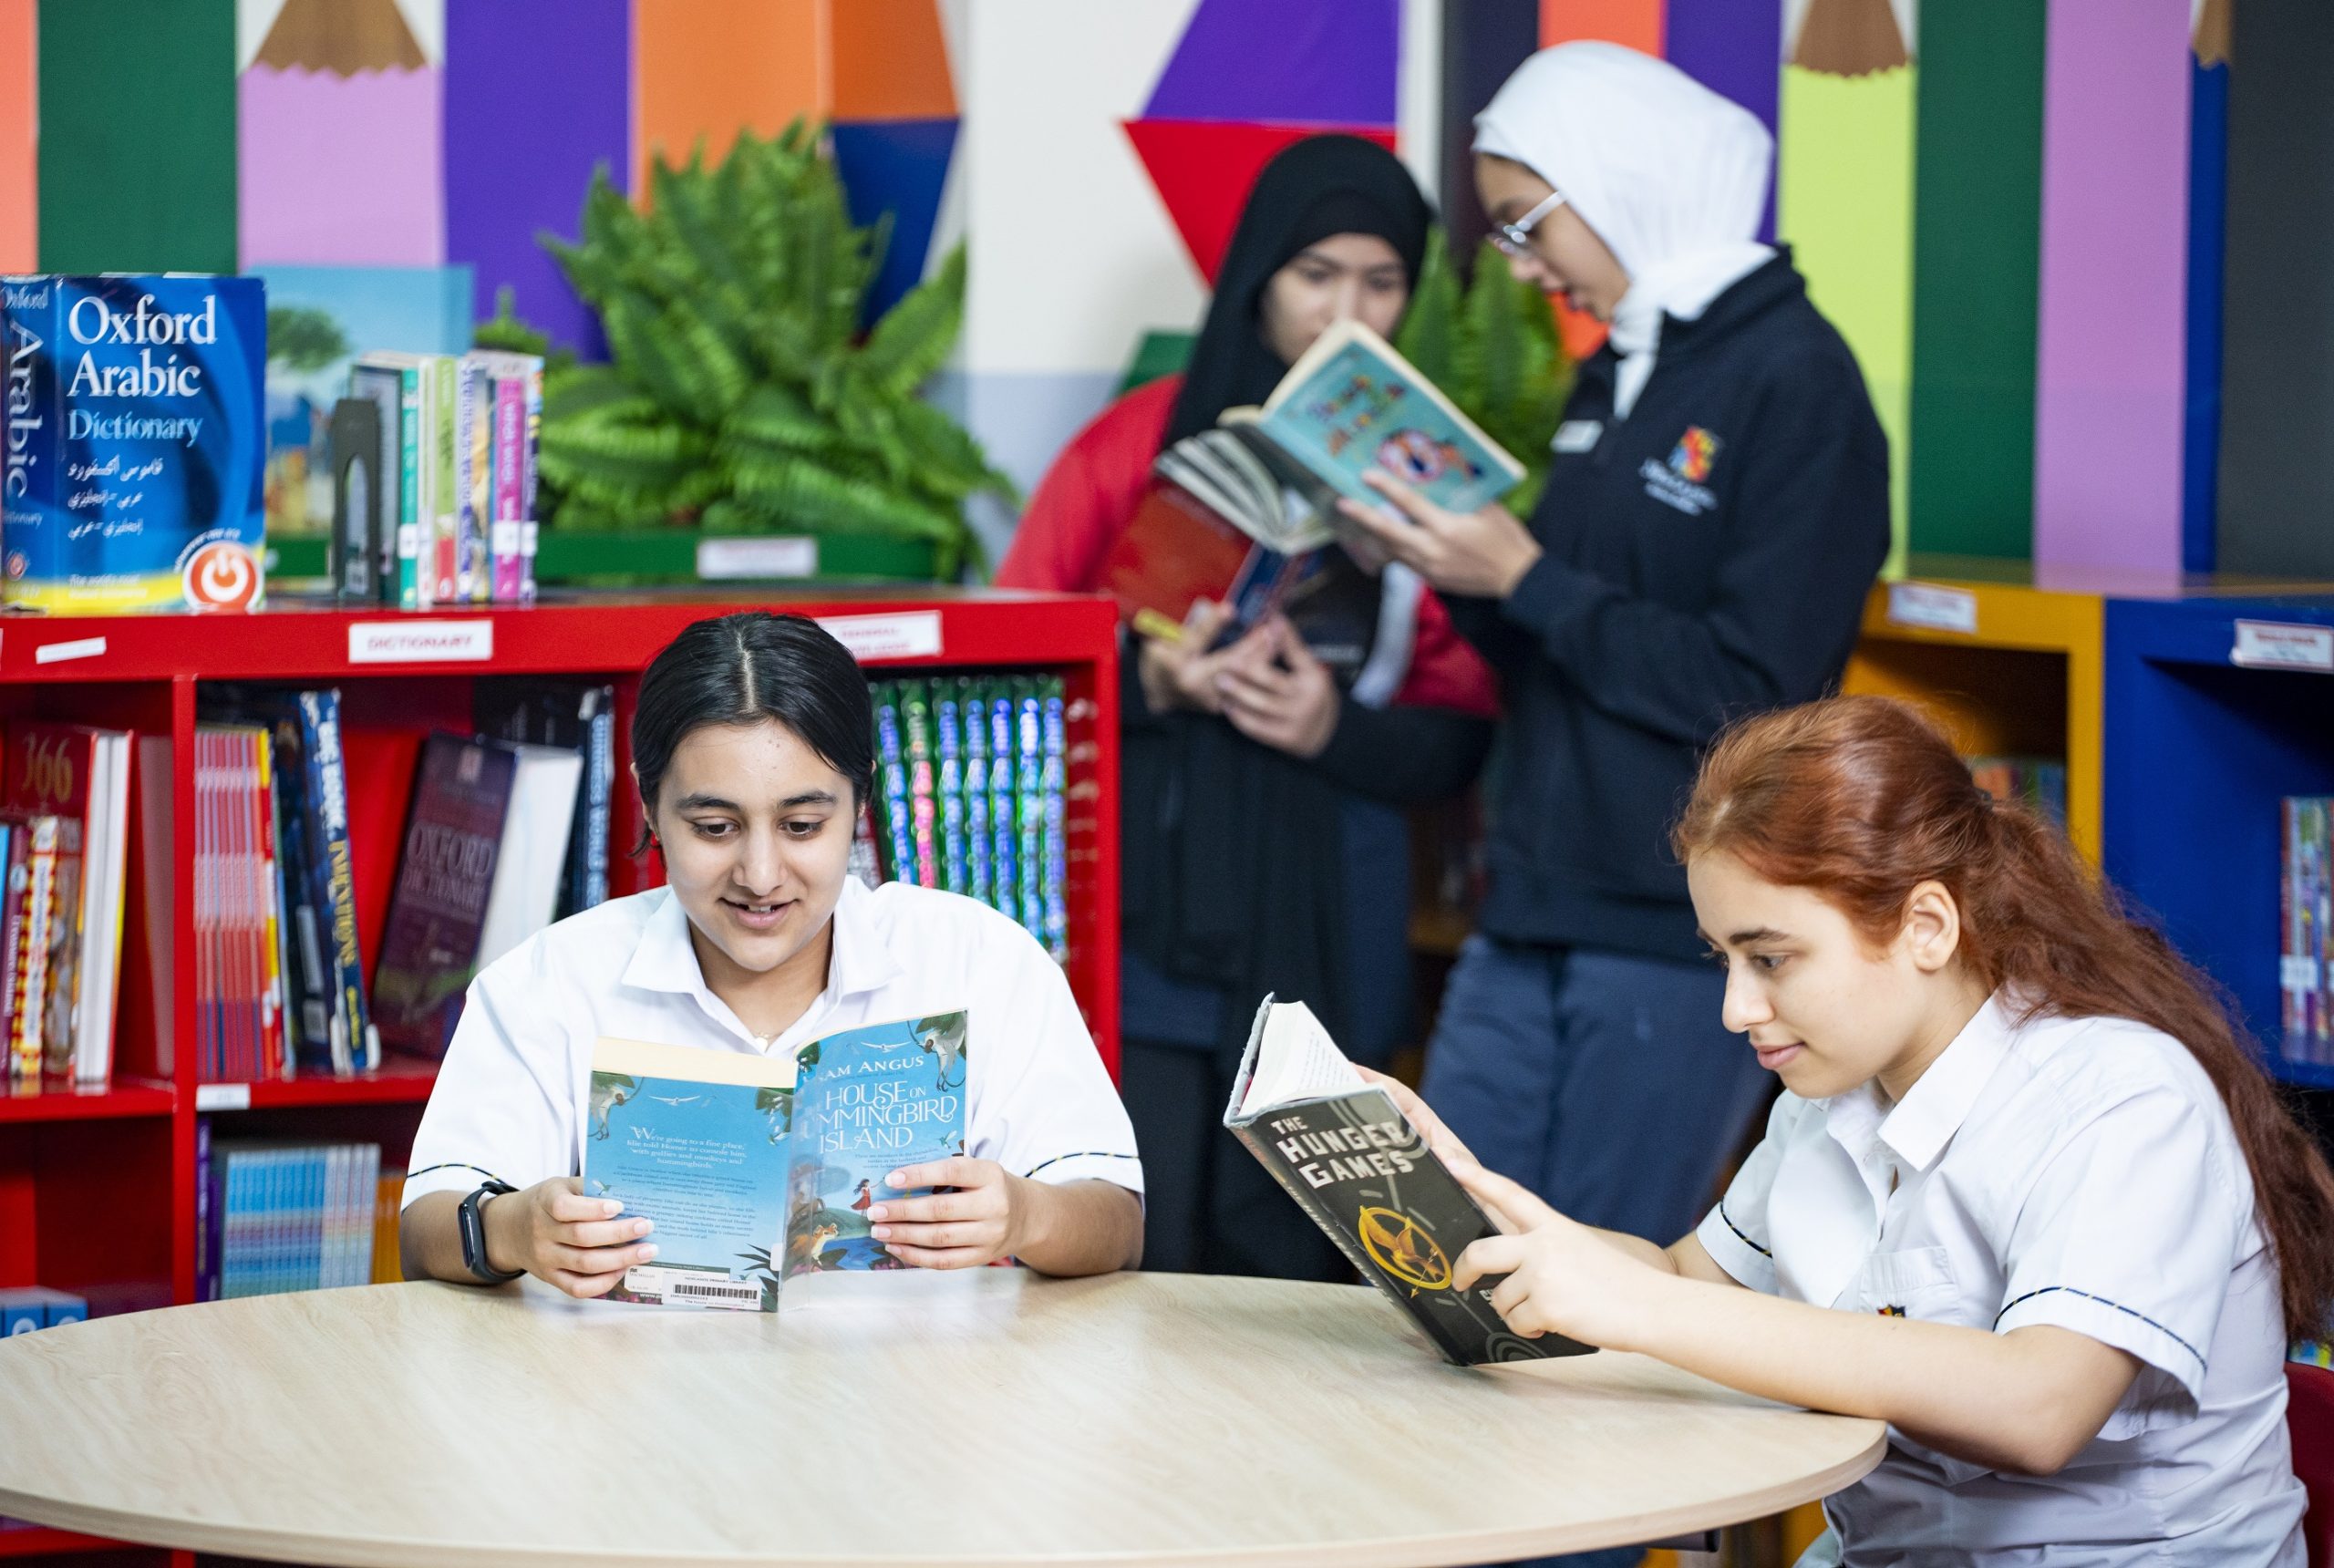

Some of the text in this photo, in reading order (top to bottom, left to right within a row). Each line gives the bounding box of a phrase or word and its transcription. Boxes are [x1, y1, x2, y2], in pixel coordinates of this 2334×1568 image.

[68, 294, 218, 346] Oxford
[67, 347, 202, 397] Arabic
[6, 319, 44, 499] Arabic
[67, 409, 203, 449] Dictionary
[367, 633, 474, 651] DICTIONARY
[408, 820, 498, 879] OXFORD
[820, 1065, 851, 1080] AM
[858, 1056, 924, 1073] ANGUS
[818, 1096, 957, 1130] MMINGBIRD
[825, 1080, 927, 1110] HOUSE ON
[820, 1127, 914, 1154] ISLAND
[1270, 1116, 1308, 1135] THE
[1276, 1121, 1409, 1163] HUNGER
[1298, 1150, 1414, 1189] GAMES
